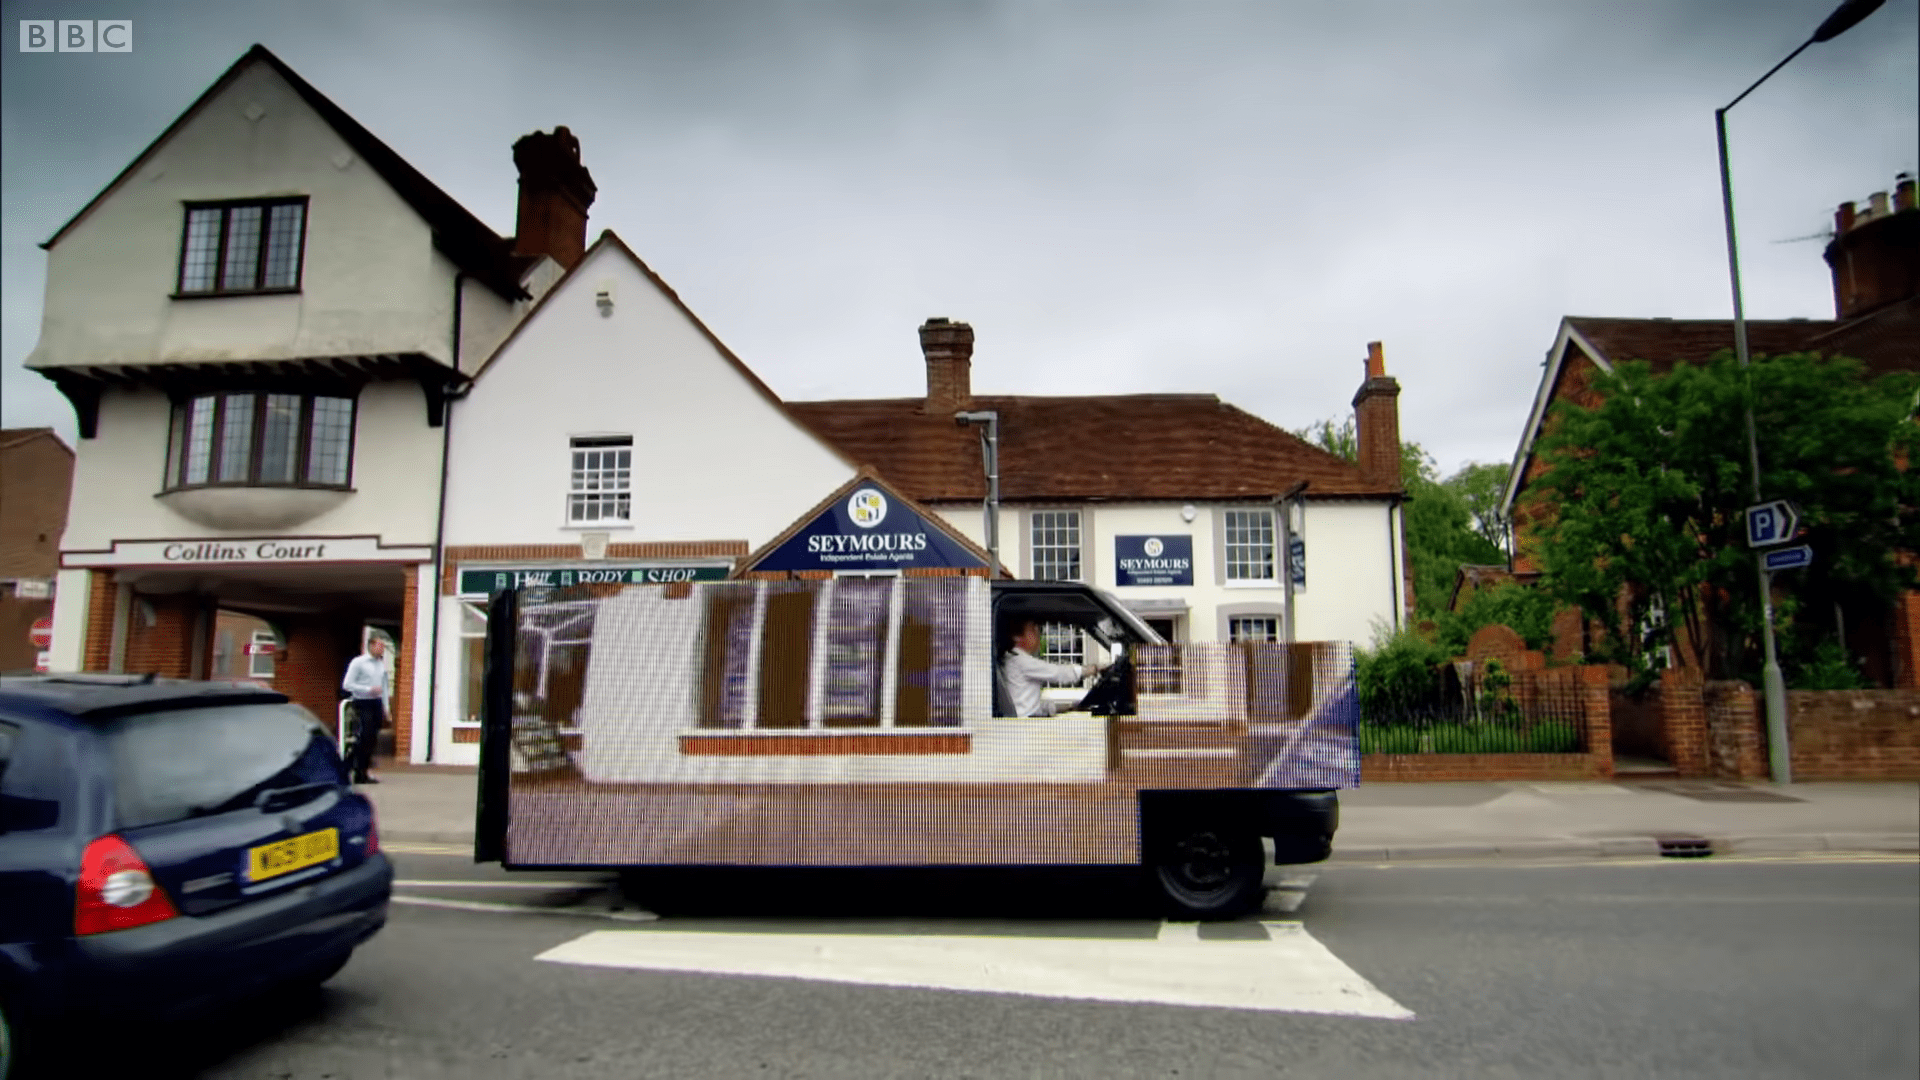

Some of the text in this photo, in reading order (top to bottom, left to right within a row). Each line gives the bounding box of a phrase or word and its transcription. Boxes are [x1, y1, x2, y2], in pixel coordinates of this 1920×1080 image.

[1755, 512, 1771, 538] P
[163, 542, 325, 561] Collins Court
[808, 533, 927, 552] SEYMOURS
[1120, 558, 1189, 569] SEYMOURS
